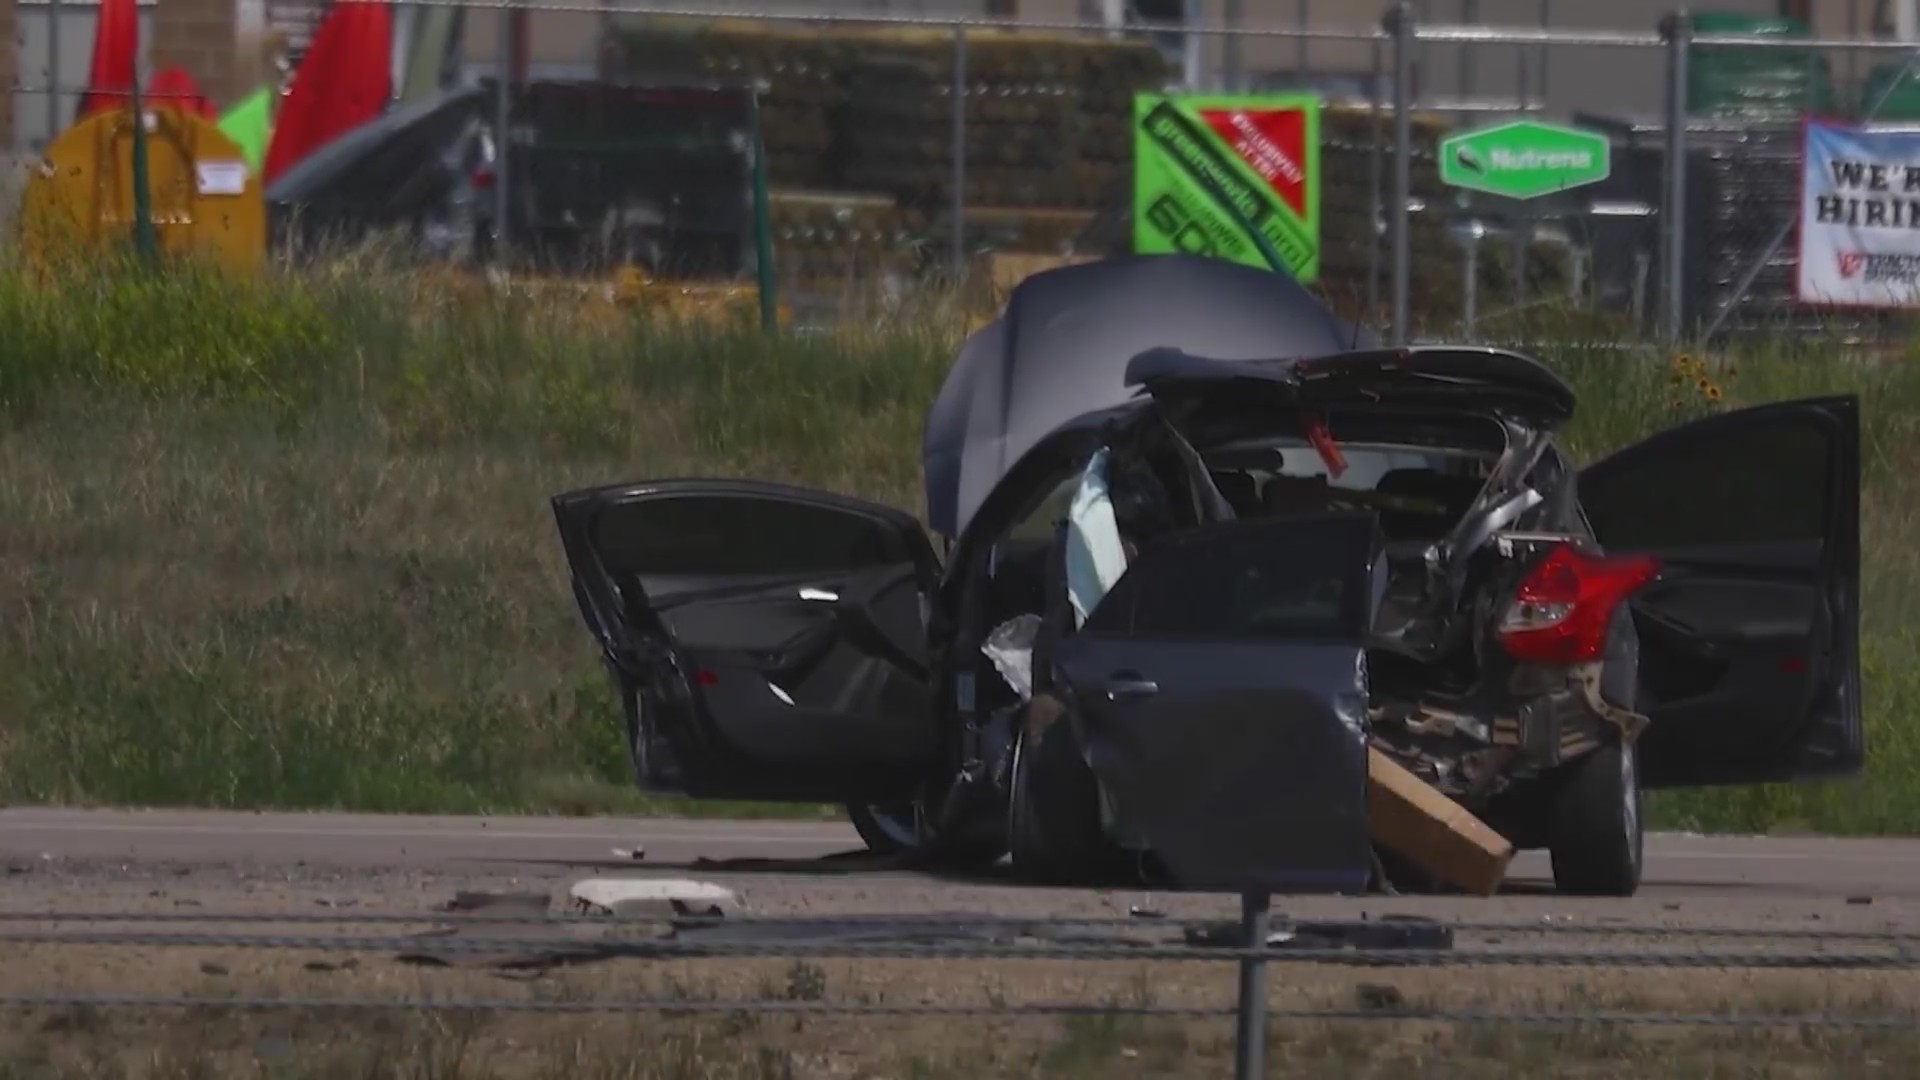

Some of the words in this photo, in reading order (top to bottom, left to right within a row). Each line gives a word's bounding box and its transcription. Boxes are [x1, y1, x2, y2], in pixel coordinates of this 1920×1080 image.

[1154, 117, 1259, 218] greenworks
[1231, 113, 1304, 184] EXCLUSIVELY
[1490, 149, 1592, 169] Nutrena
